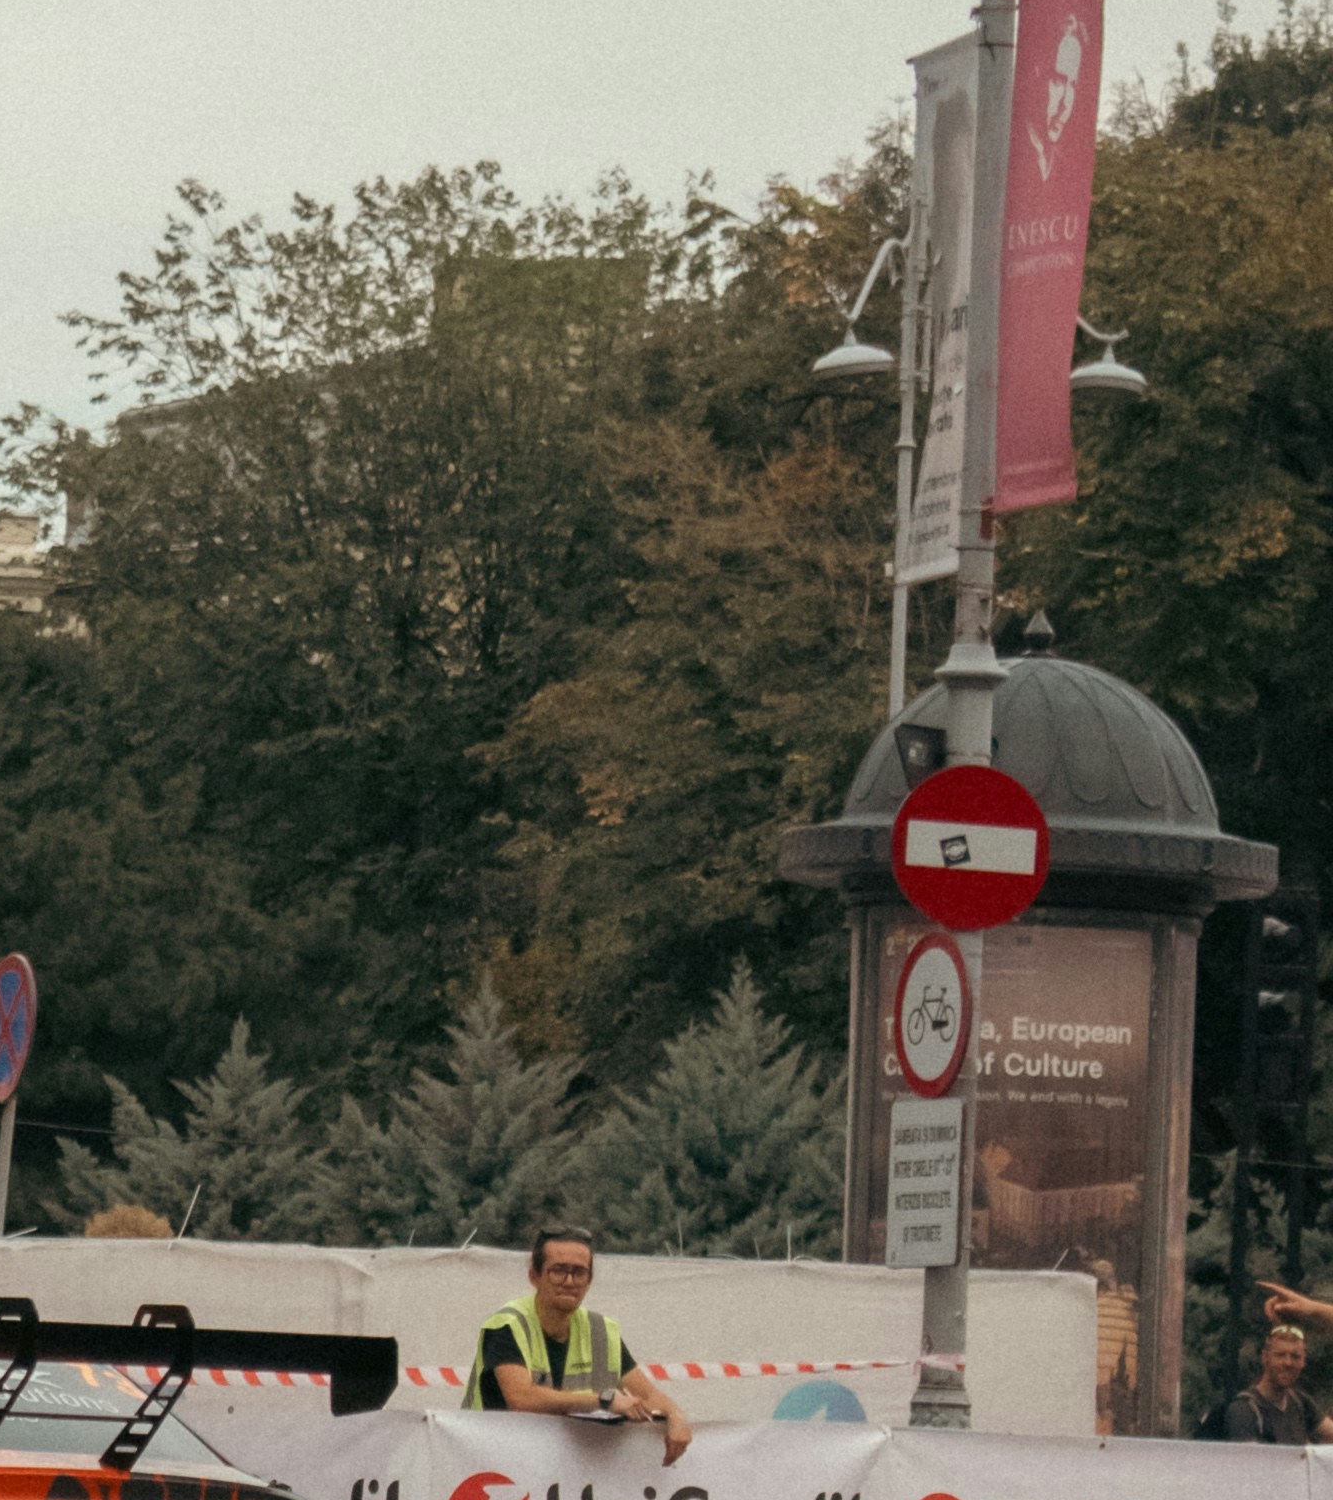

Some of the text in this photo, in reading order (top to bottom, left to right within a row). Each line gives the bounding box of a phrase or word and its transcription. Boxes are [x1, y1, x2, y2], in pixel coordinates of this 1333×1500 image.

[1008, 214, 1079, 250] ENESCU
[1011, 1016, 1133, 1049] European
[1004, 1052, 1104, 1079] Culture
